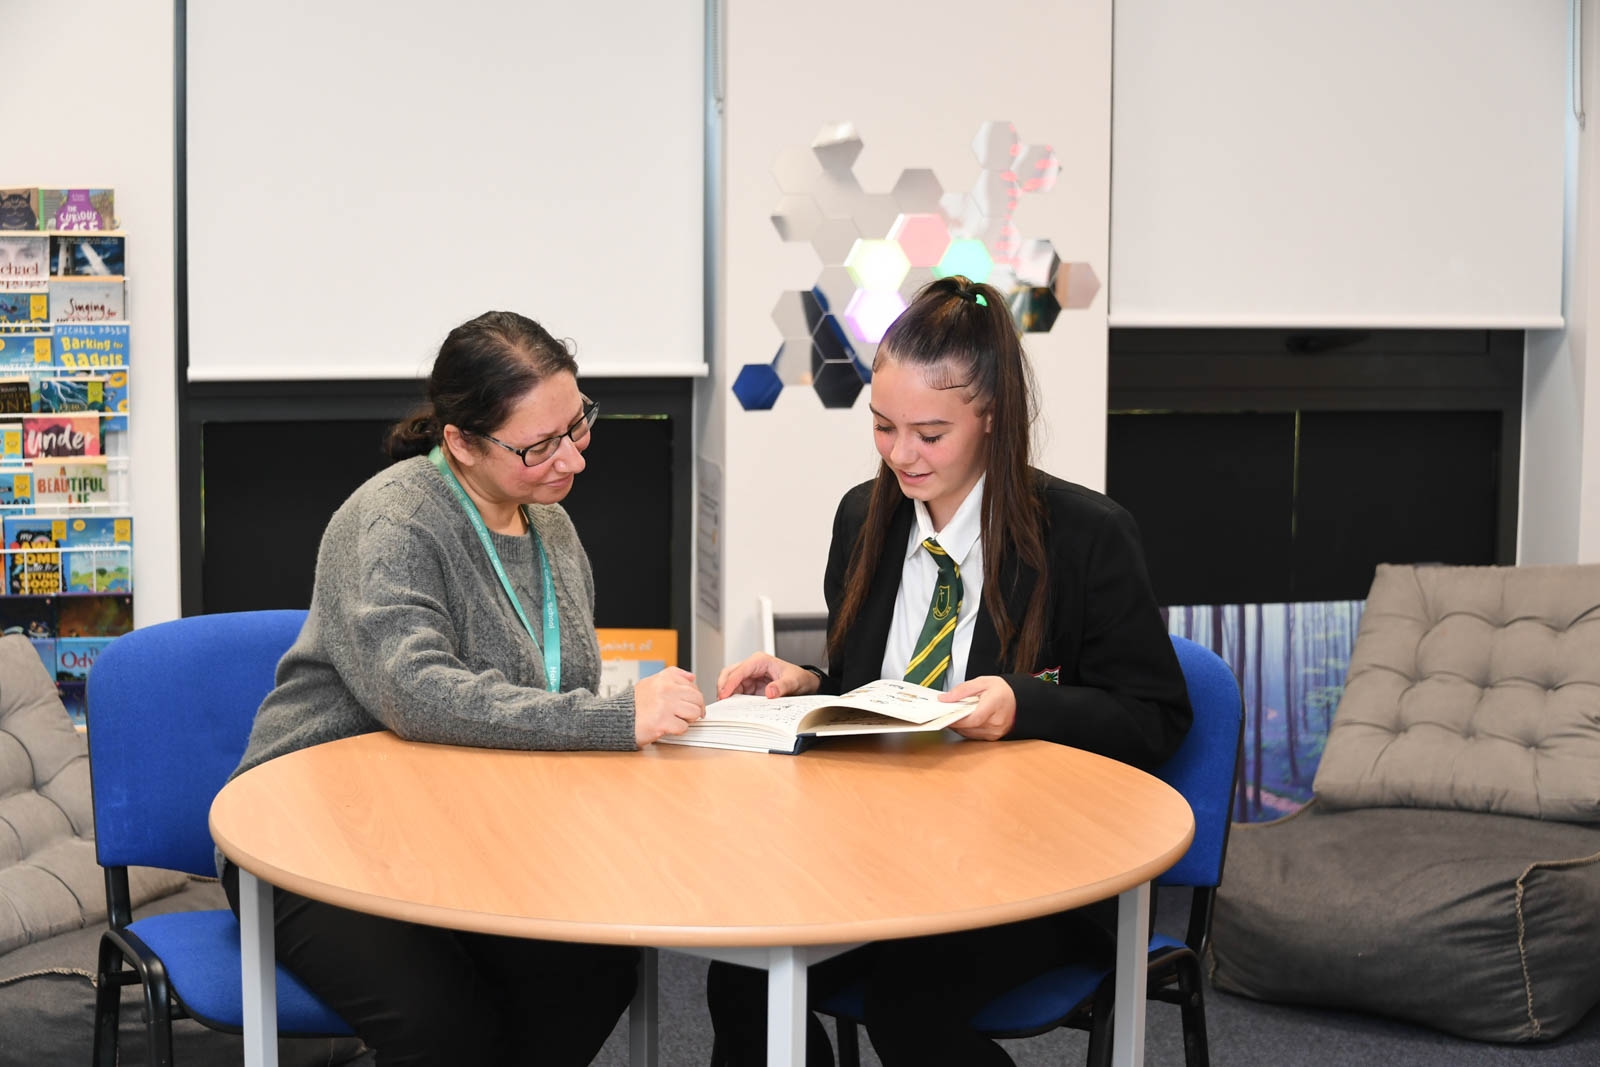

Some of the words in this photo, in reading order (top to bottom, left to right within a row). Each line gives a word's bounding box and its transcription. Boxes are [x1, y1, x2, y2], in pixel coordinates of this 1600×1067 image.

[60, 210, 97, 223] CURIOUS
[64, 298, 105, 319] Singing
[57, 327, 95, 335] MICHAEL
[61, 336, 111, 352] Barking
[61, 352, 123, 372] Bagels
[60, 466, 66, 476] A
[38, 477, 106, 493] BEAUTIFUL
[444, 473, 464, 501] School
[462, 500, 482, 531] Catholic
[15, 552, 59, 566] SOME
[21, 579, 59, 589] GOOD
